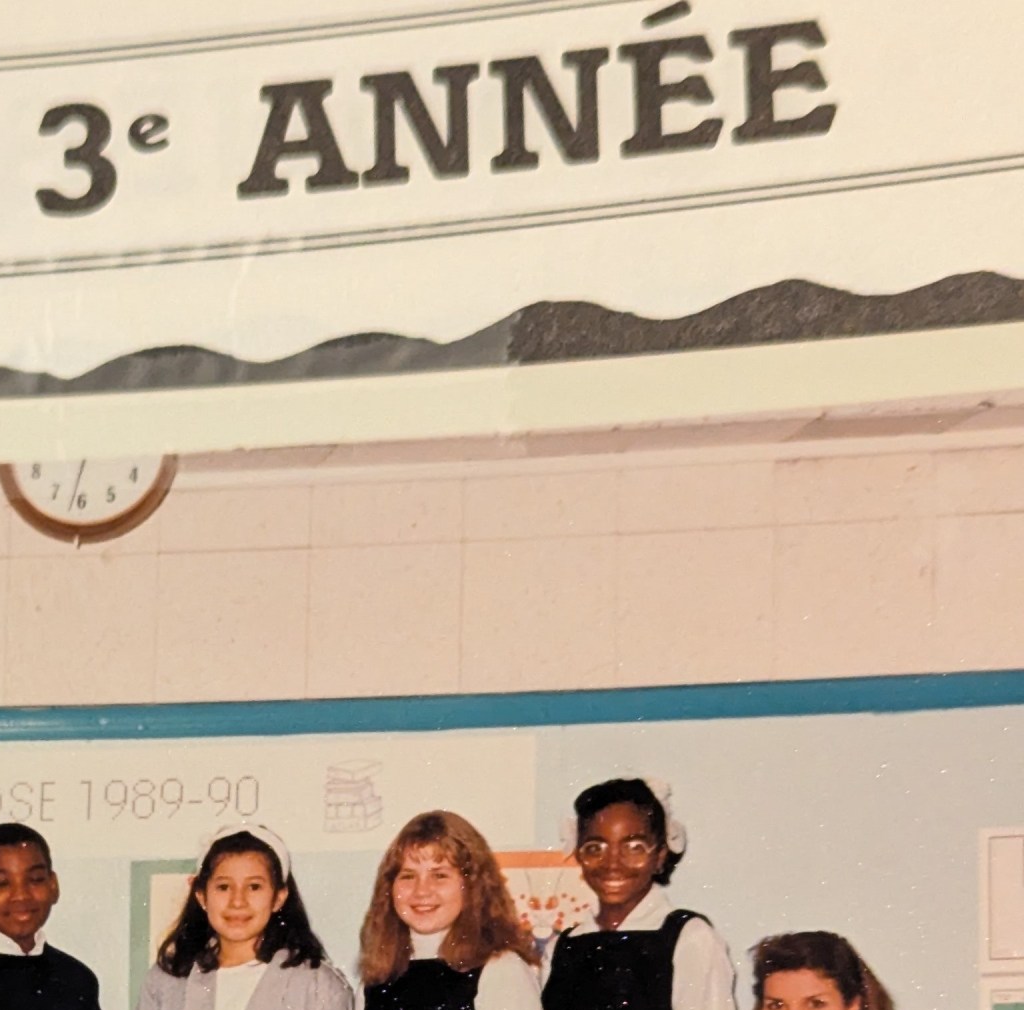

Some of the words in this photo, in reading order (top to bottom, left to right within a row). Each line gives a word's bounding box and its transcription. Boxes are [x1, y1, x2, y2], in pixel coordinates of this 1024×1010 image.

[237, 1, 838, 200] ANNÉE
[31, 464, 41, 480] 8
[129, 467, 138, 483] 4
[51, 484, 60, 500] 7
[106, 486, 115, 502] 5
[77, 494, 86, 509] 6
[81, 775, 259, 821] 1989-90
